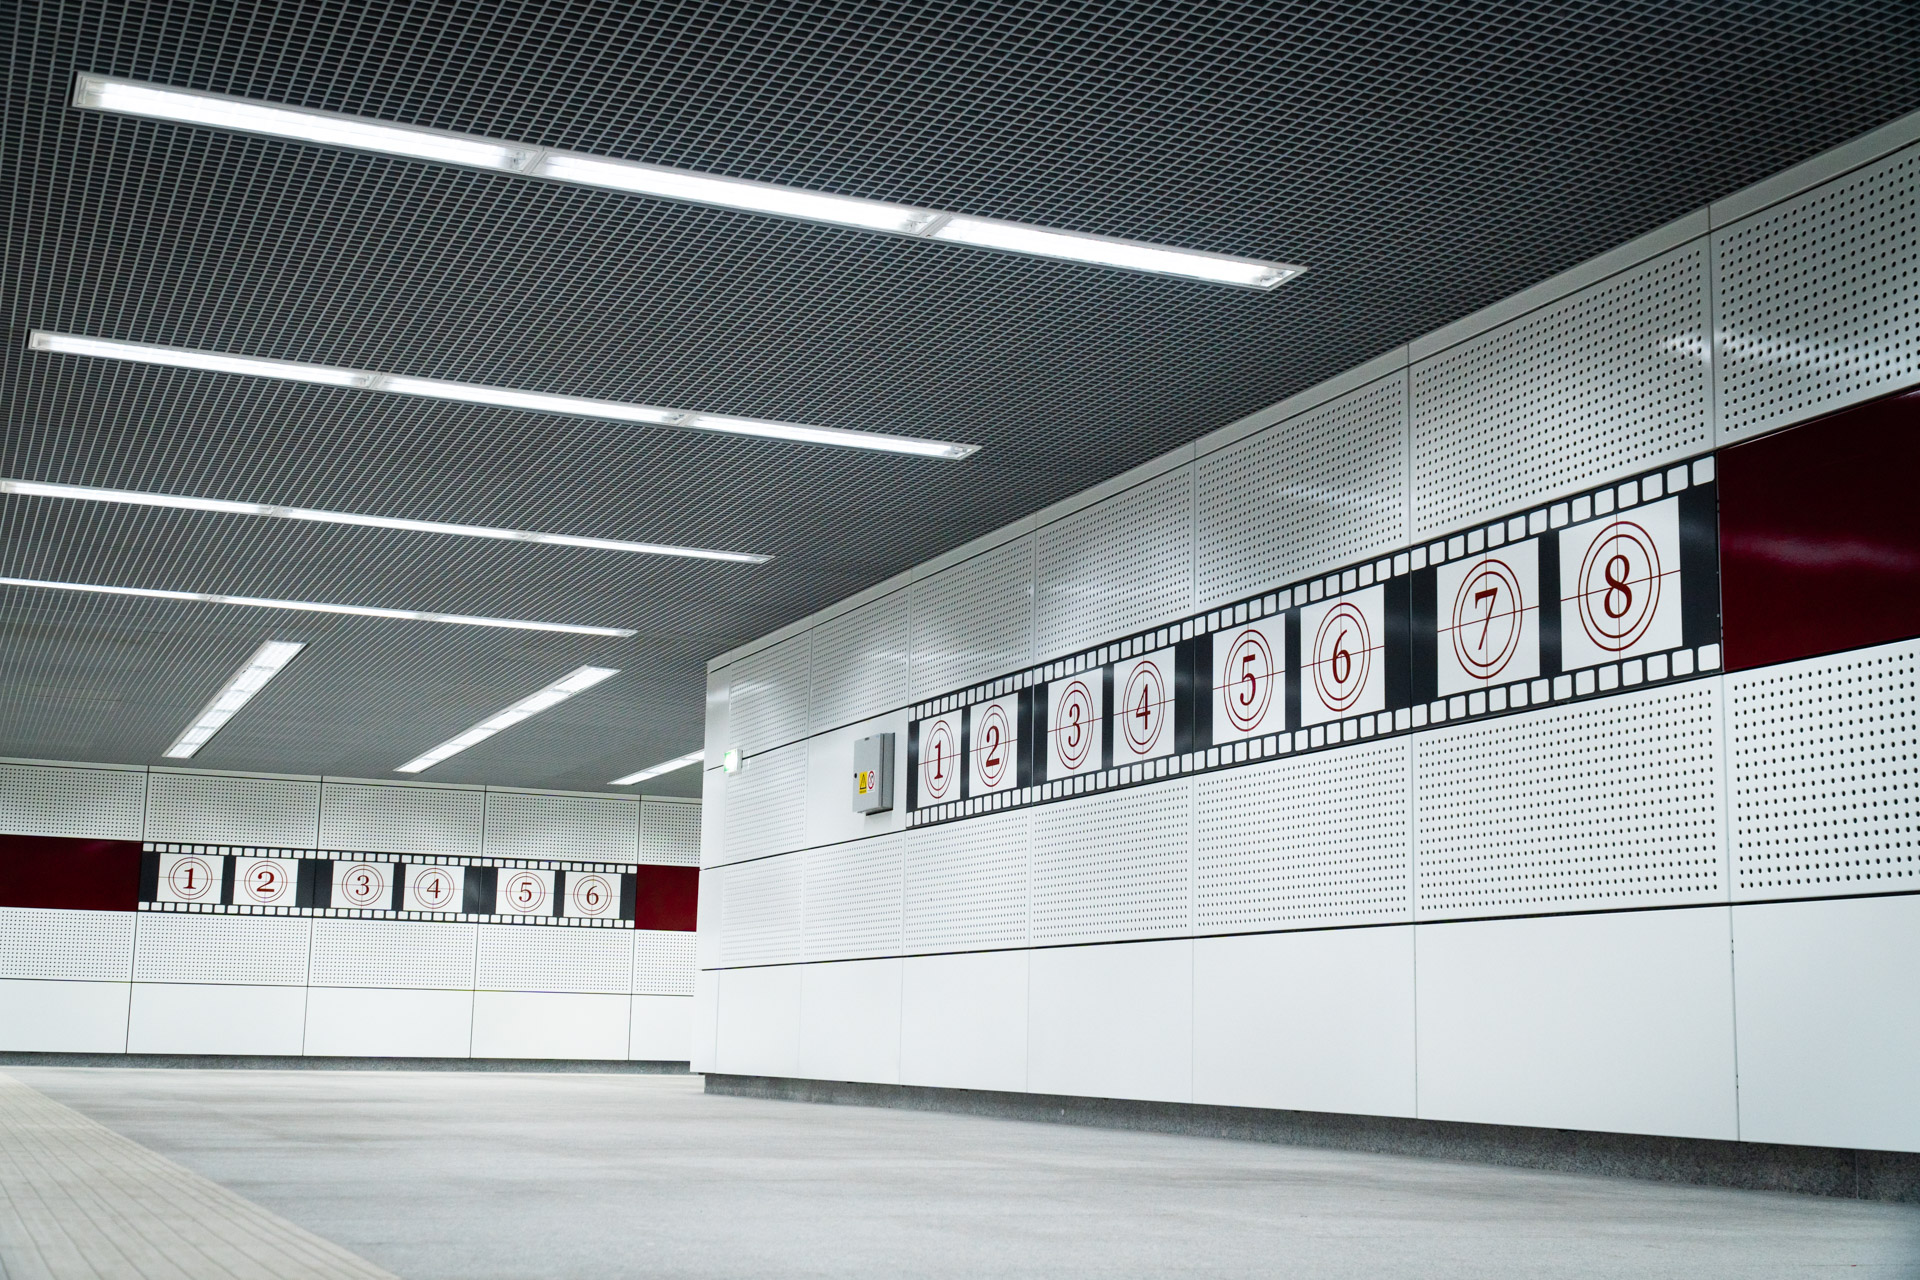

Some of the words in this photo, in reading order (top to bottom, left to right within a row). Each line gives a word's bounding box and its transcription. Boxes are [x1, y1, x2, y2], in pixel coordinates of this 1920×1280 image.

[934, 741, 943, 779] 1
[986, 725, 1000, 767] 2
[1068, 704, 1080, 747] 3
[1136, 684, 1151, 730] 4
[1240, 654, 1256, 706] 5
[1332, 630, 1351, 684] 6
[1474, 587, 1498, 650] 7
[1604, 555, 1632, 619] 8
[184, 868, 196, 890] 1
[257, 871, 274, 892] 2
[356, 875, 370, 895] 3
[426, 879, 441, 898] 4
[519, 882, 532, 902] 5
[586, 885, 599, 905] 6
